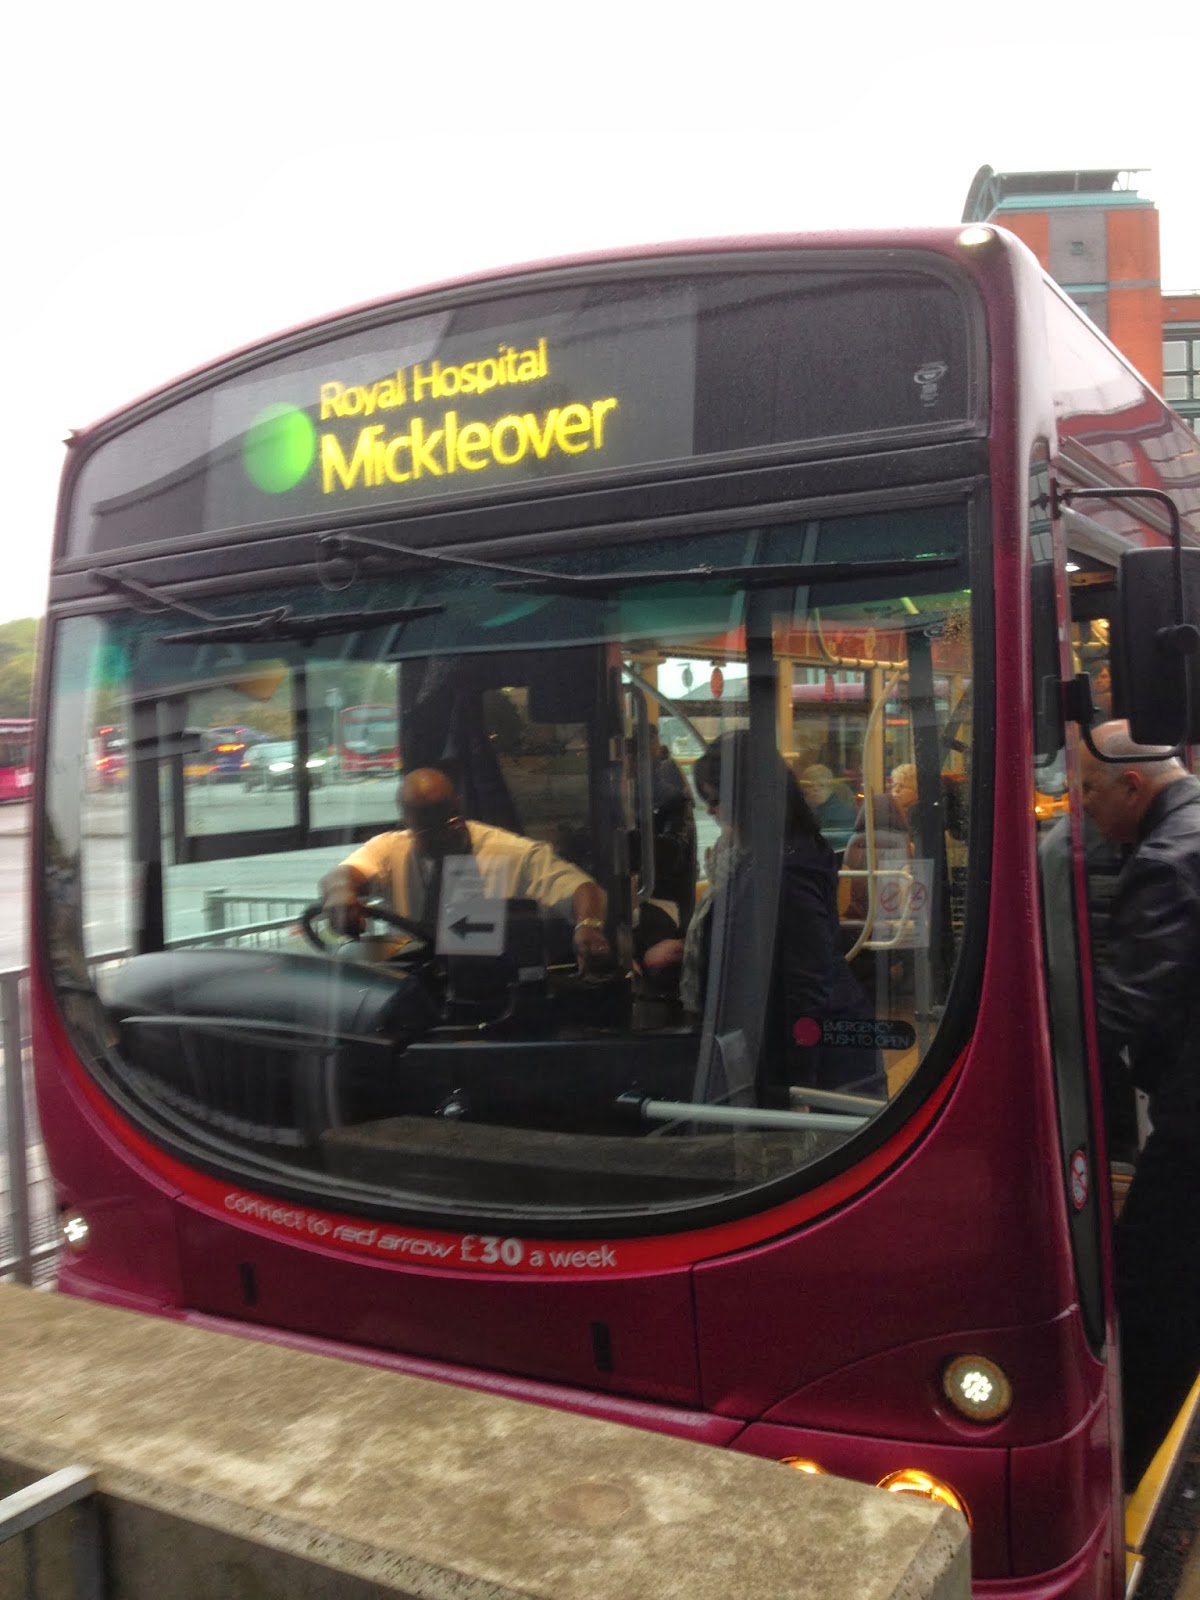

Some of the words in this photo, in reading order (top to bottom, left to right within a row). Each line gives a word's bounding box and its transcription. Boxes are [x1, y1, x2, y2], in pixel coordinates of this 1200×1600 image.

[319, 370, 405, 420] Royal
[413, 337, 549, 402] Hospital
[320, 396, 618, 494] Mickleover
[823, 1021, 893, 1033] EMERGENCY
[823, 1033, 856, 1046] PUSH
[857, 1034, 873, 1046] TO
[874, 1035, 909, 1047] OPEN
[224, 1192, 303, 1227] connect
[305, 1214, 331, 1236] to
[332, 1224, 377, 1246] red
[377, 1232, 454, 1260] arrow
[460, 1233, 523, 1266] £30
[529, 1252, 544, 1267] a
[549, 1244, 617, 1269] week
